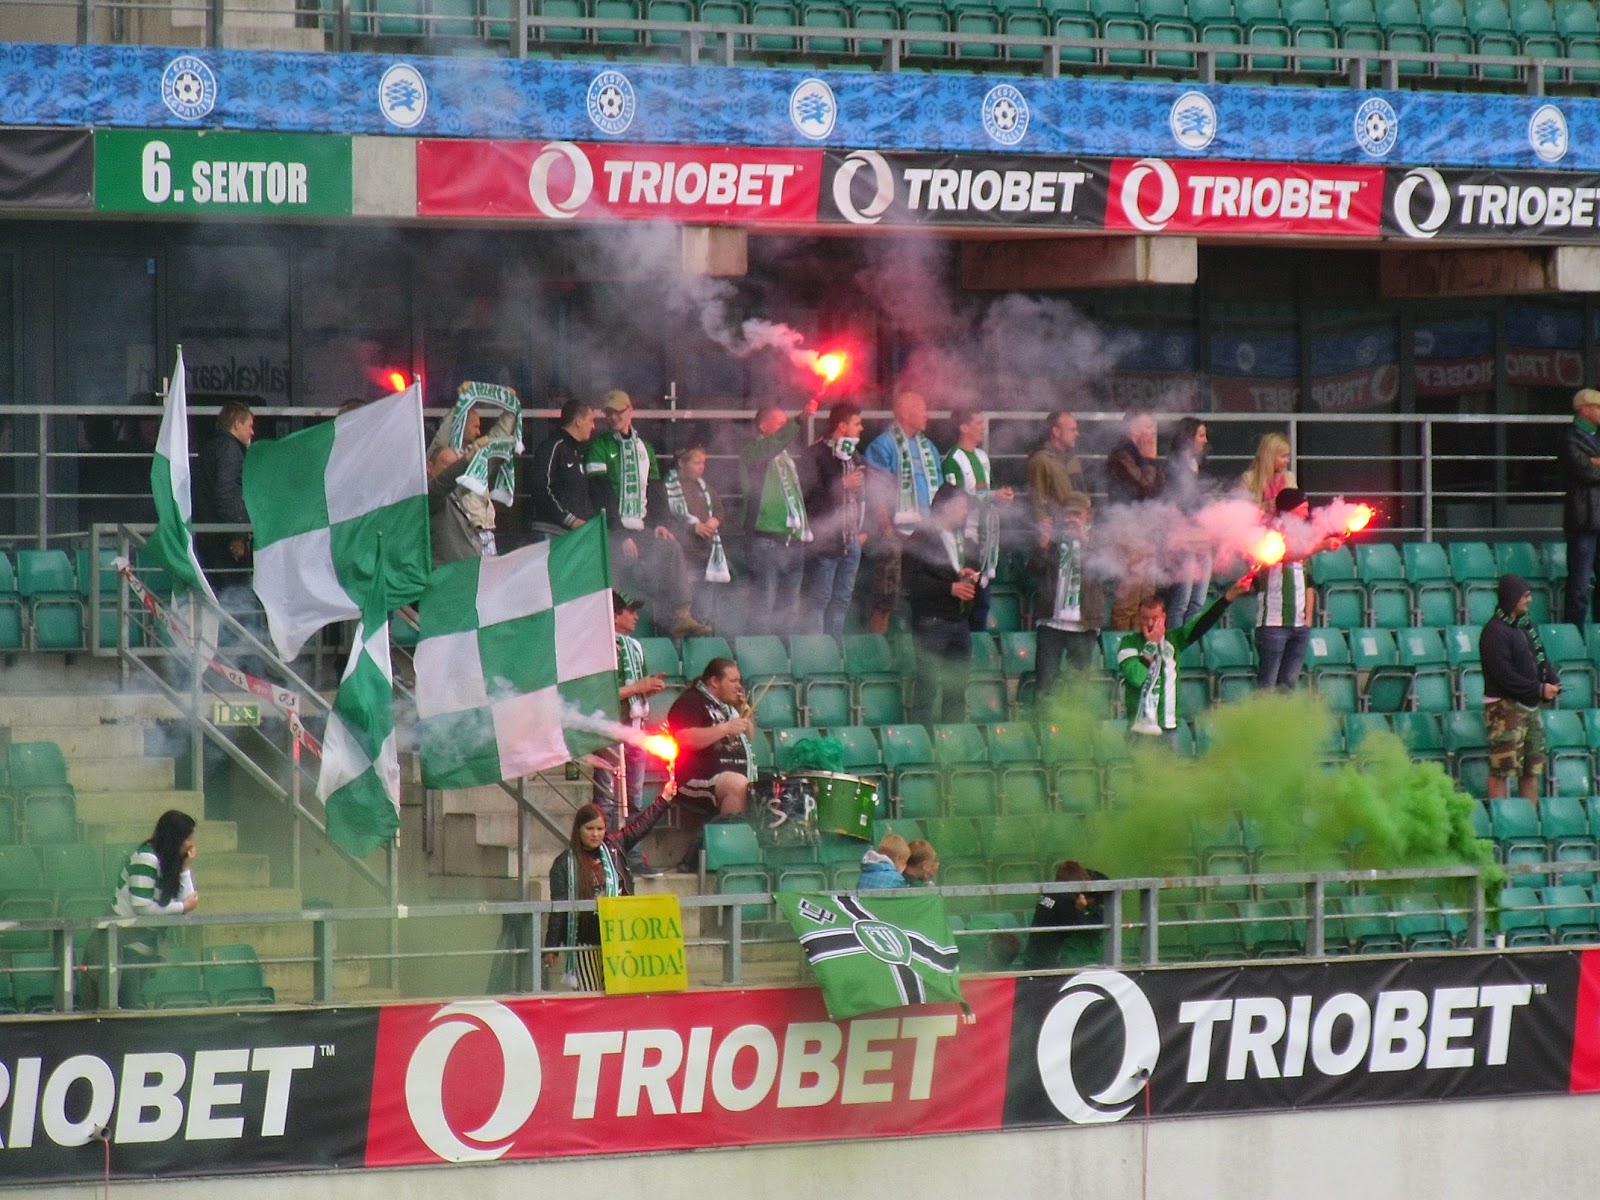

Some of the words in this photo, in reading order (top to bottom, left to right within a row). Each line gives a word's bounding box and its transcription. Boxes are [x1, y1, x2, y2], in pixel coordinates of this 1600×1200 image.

[141, 140, 185, 203] 6.
[192, 160, 308, 204] SEKTOR
[603, 160, 794, 206] TRIOBET
[903, 168, 1085, 213] TRIOBET
[1188, 175, 1362, 220] TRIOBET
[1458, 184, 1600, 228] TRIOBE
[604, 916, 682, 942] FLORA
[605, 947, 684, 979] VÕIDA!
[1179, 983, 1533, 1084] TRIOBET
[563, 1014, 958, 1120] TRIOBET
[0, 1045, 315, 1150] IOBET
